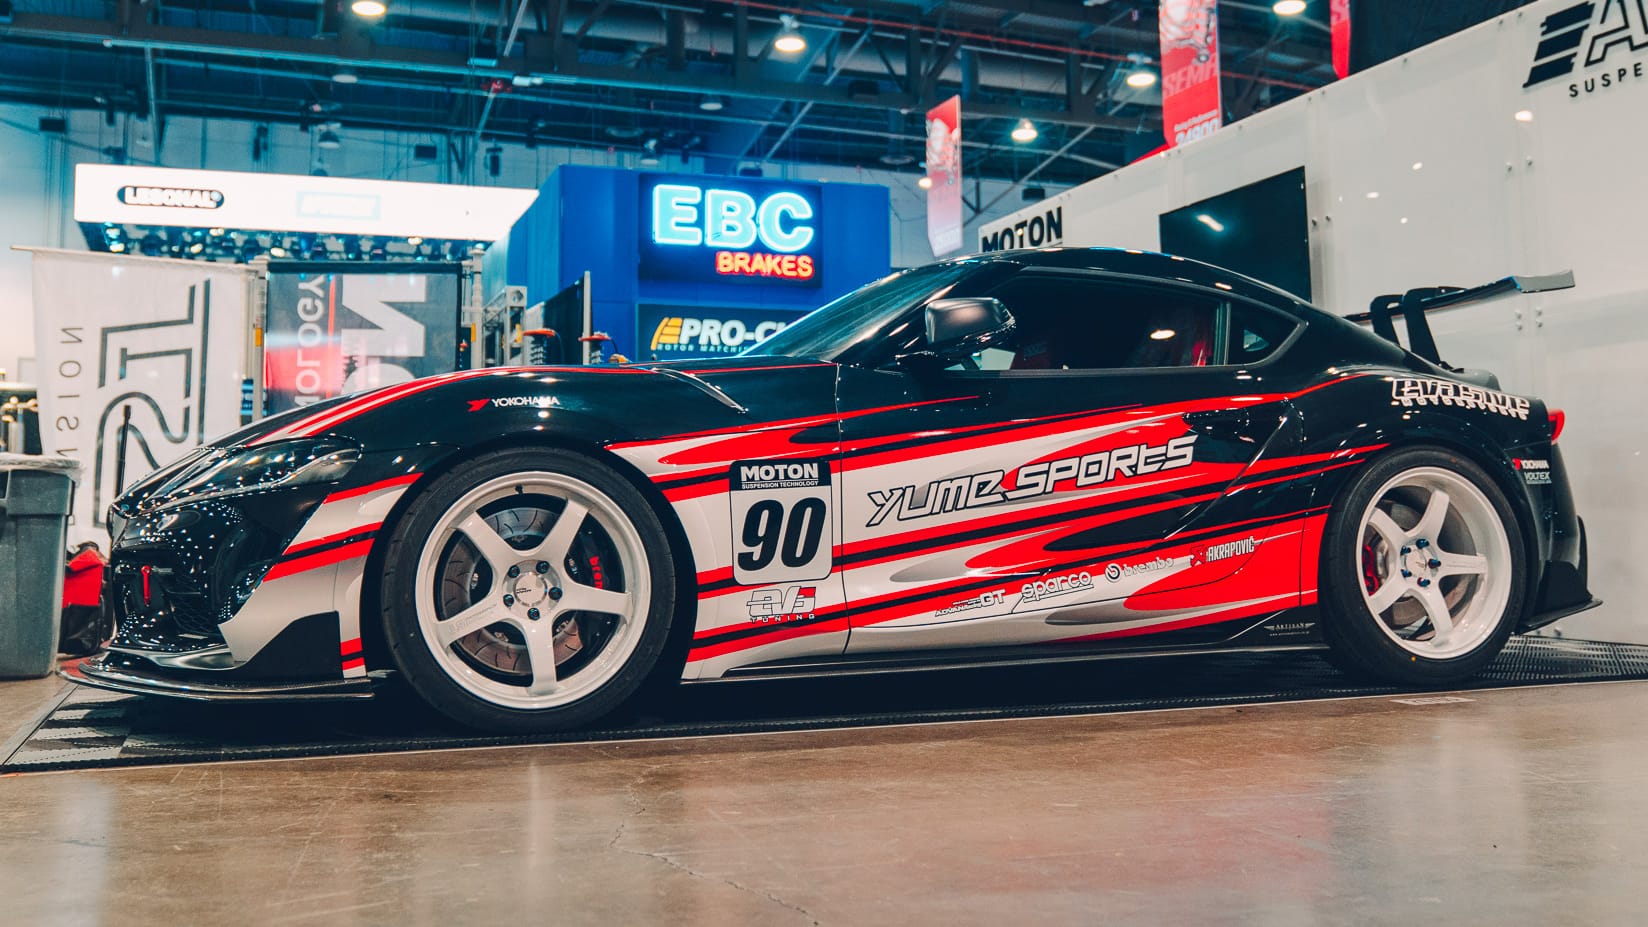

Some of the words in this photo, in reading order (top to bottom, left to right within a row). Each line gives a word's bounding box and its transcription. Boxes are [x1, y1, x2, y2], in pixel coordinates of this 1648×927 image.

[1569, 62, 1643, 98] SUSPE
[653, 184, 814, 252] EBC
[982, 206, 1062, 252] MOTON
[716, 251, 815, 280] BRAKES
[679, 318, 788, 347] PRO-C
[491, 396, 561, 408] YOKOHAMA
[741, 463, 818, 481] MOTON
[742, 482, 779, 490] SUSPENSION
[780, 480, 819, 488] TECHNOLOGY
[738, 497, 827, 571] 90
[1123, 556, 1175, 577] brembo
[979, 589, 1006, 608] GT
[1021, 571, 1092, 600] sparco
[750, 613, 815, 624] TUNING
